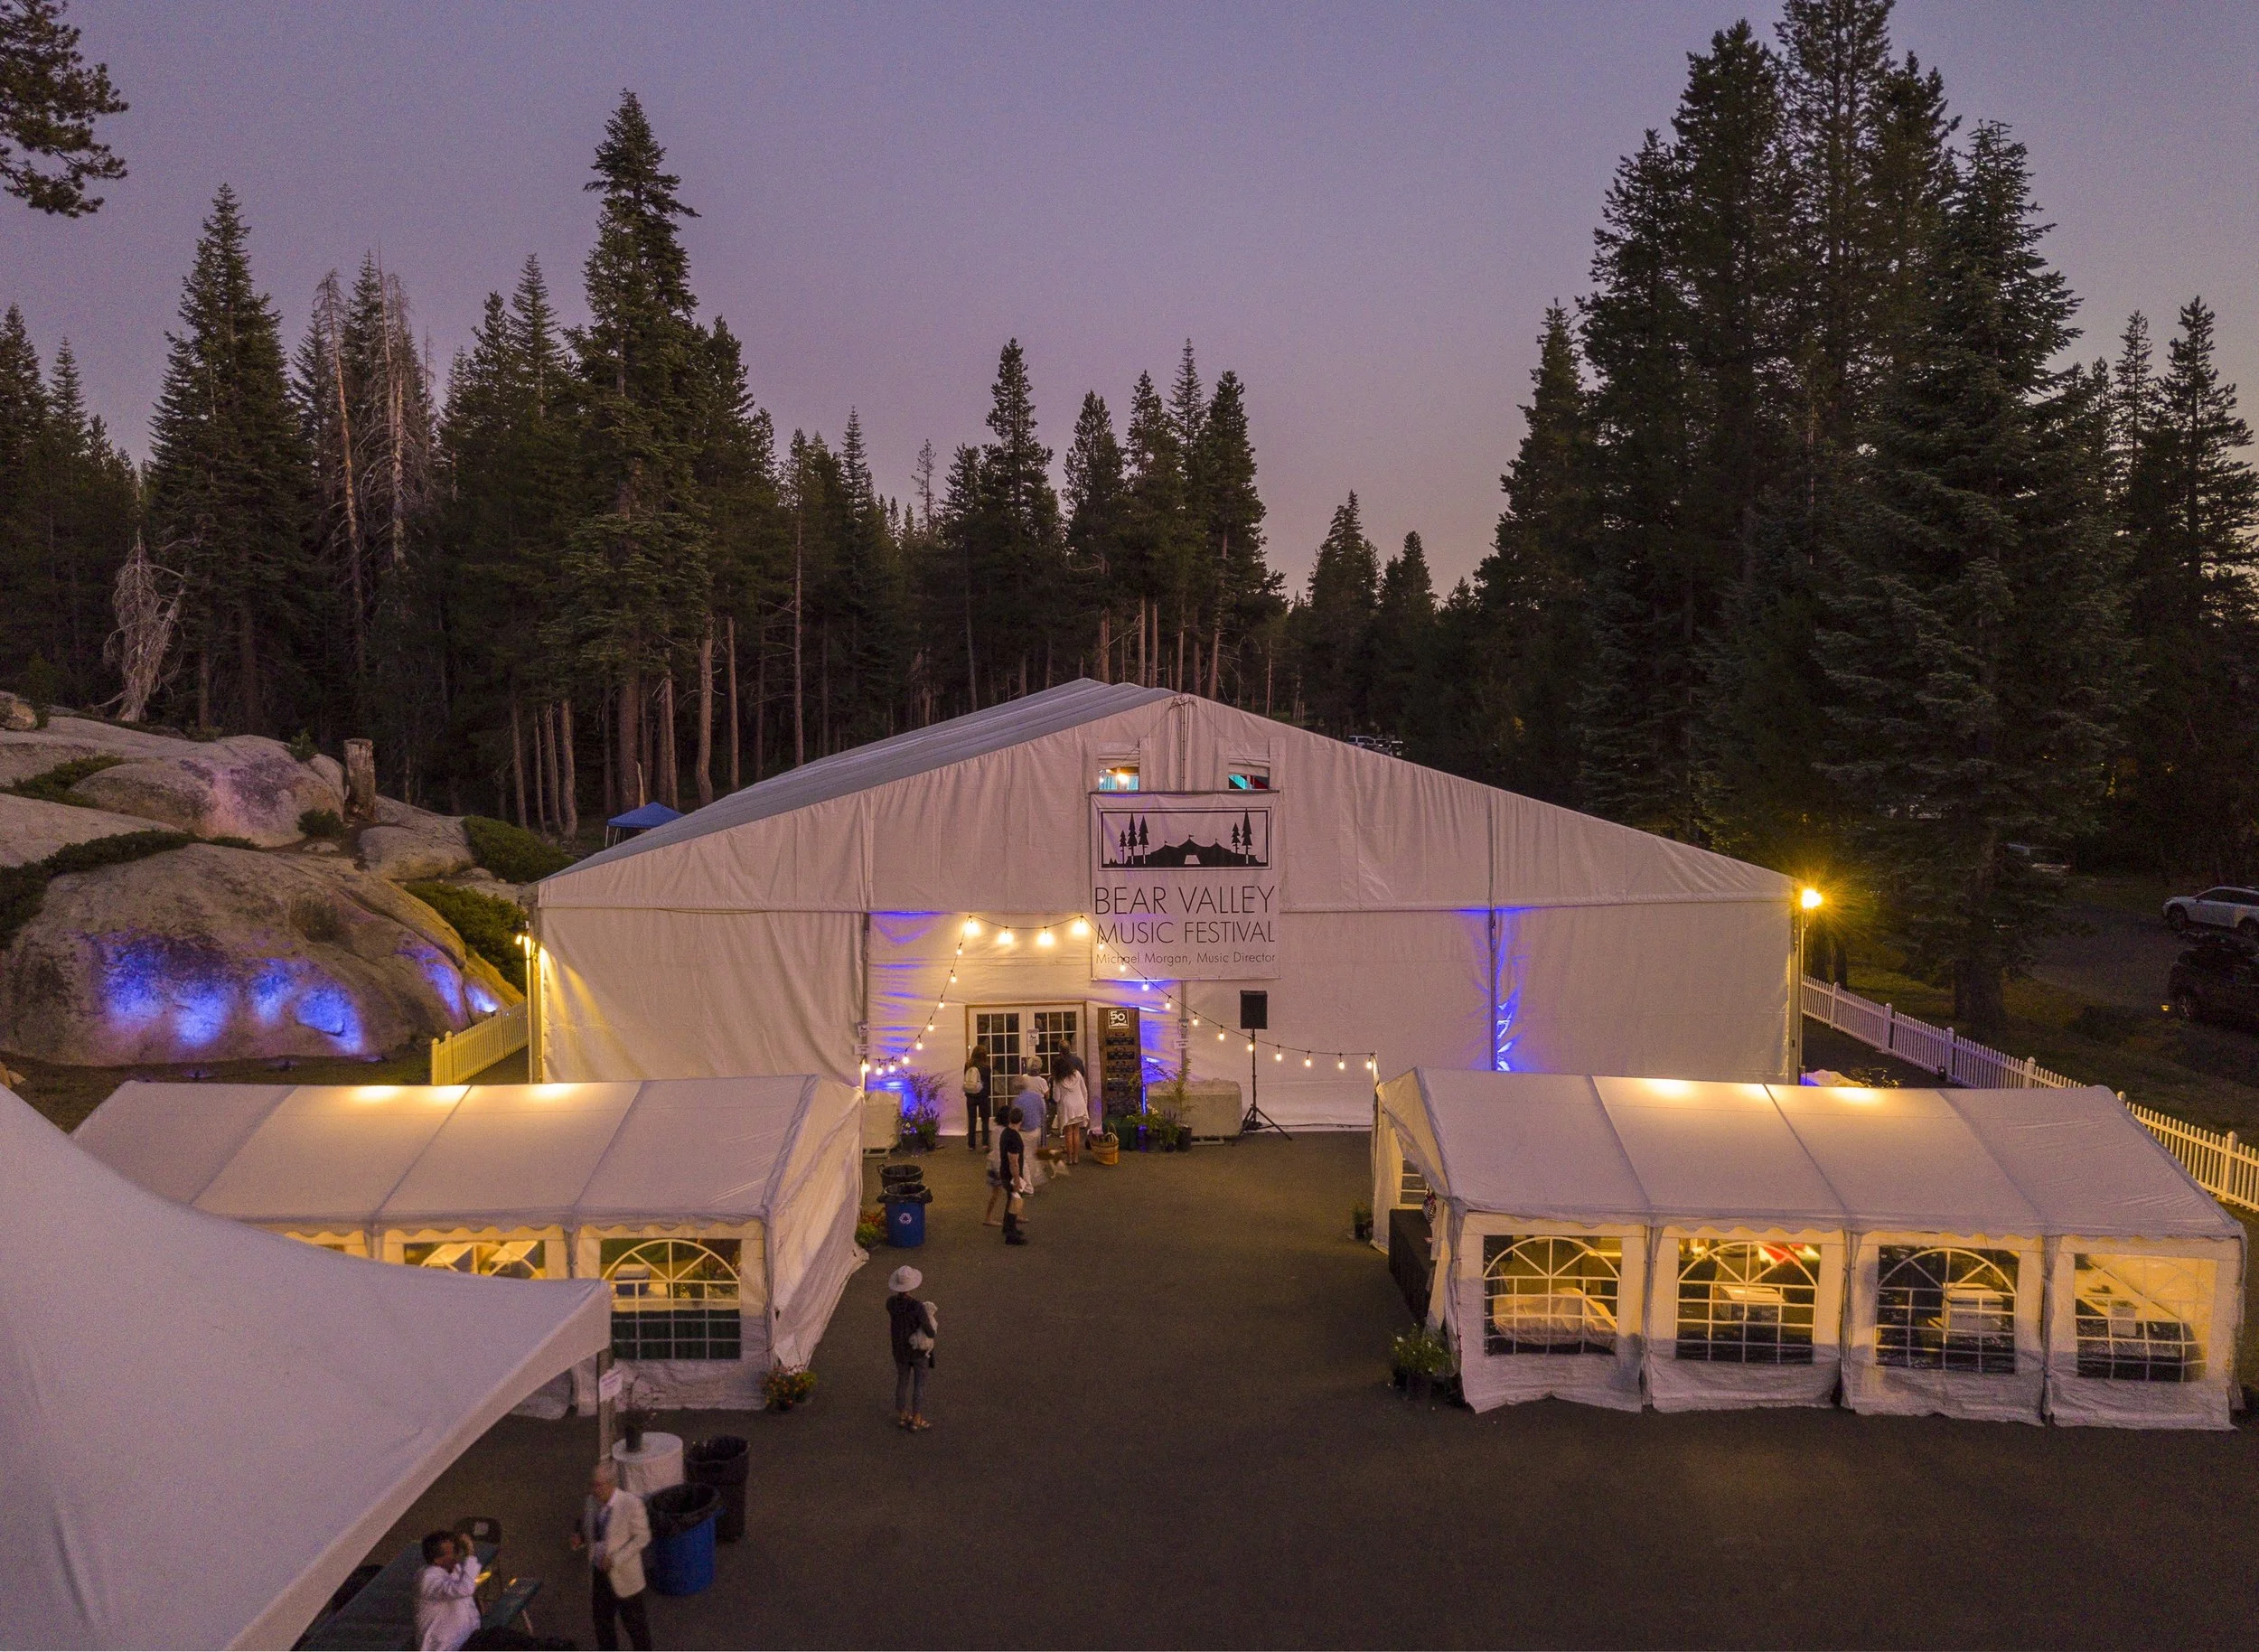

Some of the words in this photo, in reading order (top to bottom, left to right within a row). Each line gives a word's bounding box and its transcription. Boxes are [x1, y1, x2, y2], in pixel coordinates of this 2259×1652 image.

[1094, 886, 1167, 915] BEAR
[1177, 885, 1276, 915] VALLEY
[1096, 921, 1175, 945] MUSIC
[1185, 920, 1276, 943] FESTIVAL
[1095, 952, 1140, 964] Michael
[1144, 952, 1192, 967] Morgan,
[1196, 952, 1229, 964] Music
[1233, 951, 1276, 963] Director
[1110, 1010, 1126, 1021] 50
